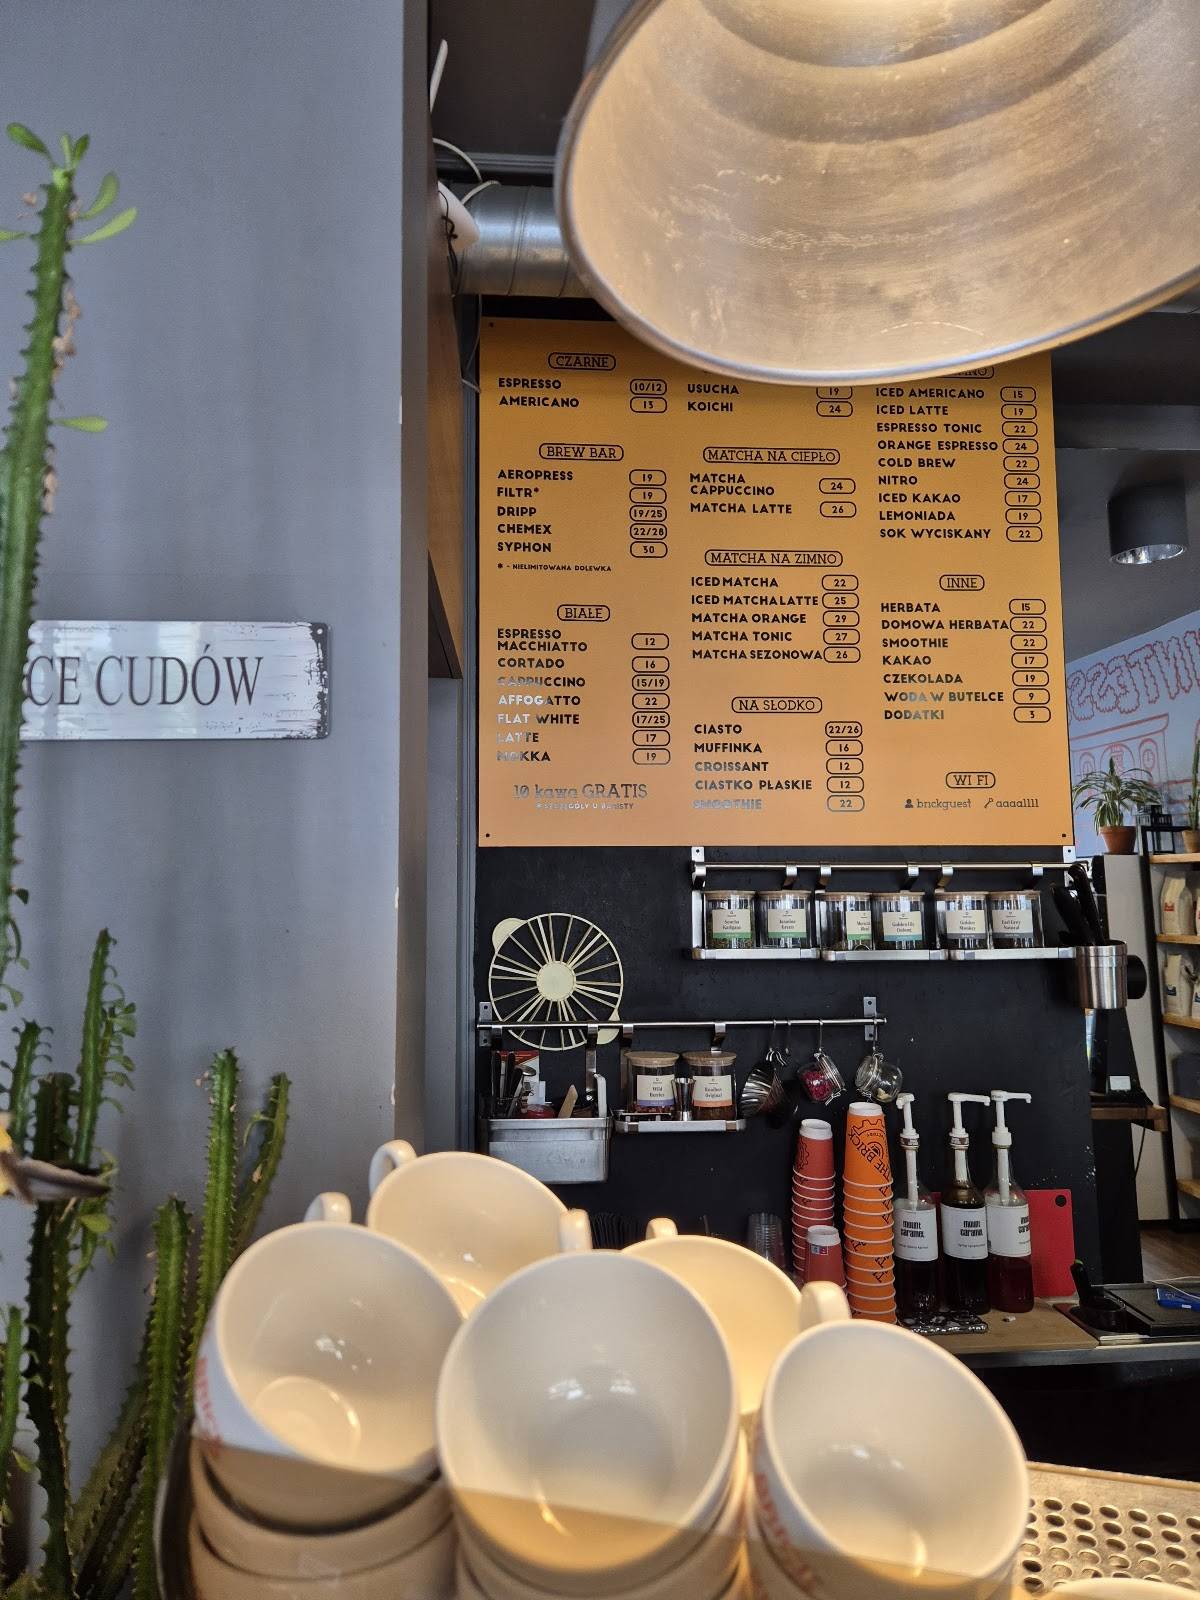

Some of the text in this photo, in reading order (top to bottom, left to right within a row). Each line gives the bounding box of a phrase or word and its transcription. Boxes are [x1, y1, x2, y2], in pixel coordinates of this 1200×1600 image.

[554, 355, 610, 369] CZARNE
[499, 378, 561, 389] ESPRESSO
[635, 383, 661, 391] 10/12
[688, 384, 739, 394] USUCHA
[830, 387, 839, 395] 19
[876, 386, 984, 398] ICED AMERICANO
[499, 396, 579, 407] AMERICANO
[688, 402, 733, 412] KOICHI
[829, 405, 841, 413] 24
[877, 405, 948, 415] ICED LATTE
[877, 423, 982, 433] ESPRESSO TONIC
[1014, 425, 1026, 433] 22
[878, 440, 998, 450] ORANGE ESPRESSO
[545, 446, 618, 460] BREW BAR
[707, 448, 837, 463] MATCHA NA CIEPŁO
[878, 458, 955, 467] COLD BREW
[498, 470, 573, 480] AEROPRESS
[643, 474, 652, 482] 19
[690, 473, 745, 483] MATCHA
[879, 475, 917, 485] NITRO
[691, 485, 774, 495] CAPPUCCINO
[831, 482, 843, 490] 24
[879, 493, 960, 503] ICED KAKAO
[497, 506, 536, 516] DRIPP
[632, 508, 664, 519] 19/25
[691, 503, 793, 515] MATCHA LATTE
[880, 511, 955, 520] LEMONIADA
[498, 524, 552, 534] CHEMEX
[632, 526, 665, 538] 22/28
[880, 529, 991, 538] SOK WYCISKANY
[1019, 530, 1030, 538] 22
[498, 542, 551, 552] SYPHON
[709, 550, 836, 565] MATCHA NA ZIMNO
[692, 575, 780, 588] ICED MATCHA
[834, 579, 846, 587] 22
[947, 578, 977, 588] INNE
[692, 594, 819, 607] ICED MATCHA LATTE
[881, 603, 940, 612] HERBATA
[1022, 603, 1030, 611] 15
[565, 608, 602, 618] BIAŁE
[692, 612, 807, 625] MATCHA ORANGE
[882, 620, 1009, 629] DOMOWA HERBATA
[498, 628, 561, 639] ESPRESSO
[692, 630, 793, 643] MATCHA TONIC
[498, 641, 587, 651] MACCHIATTO
[883, 638, 948, 647] SMOOTHIE
[693, 648, 823, 662] MATCHA SEZONOWA
[836, 651, 847, 659] 26
[498, 658, 564, 668] CORTADO
[883, 656, 931, 665] KAKAO
[96, 644, 264, 706] CUDÓW
[884, 674, 962, 683] CZEKOLADA
[497, 677, 586, 687] CAPPUCCINO
[635, 679, 664, 689] 15/19
[499, 695, 581, 706] AFFOGATTO
[645, 697, 657, 705] 22
[884, 692, 1003, 702] WODA W BUTELCE
[739, 700, 816, 713] NA SŁODKO
[498, 714, 579, 724] FLAT WHITE
[884, 710, 945, 720] DODATKI
[635, 716, 667, 726] 17/25
[695, 724, 742, 734] CIASTO
[829, 724, 860, 733] 22/26
[497, 732, 540, 743] LATTE
[646, 734, 656, 742] 17
[695, 743, 762, 753] MUFFINKA
[840, 744, 849, 752] 16
[694, 761, 769, 772] CROISSANT
[840, 762, 849, 770] 12
[953, 775, 988, 785] WI FI
[695, 780, 813, 791] CIASTKO PŁASKIE
[513, 785, 530, 799] 10
[581, 783, 648, 799] GRATIS
[917, 799, 972, 810] brickguest
